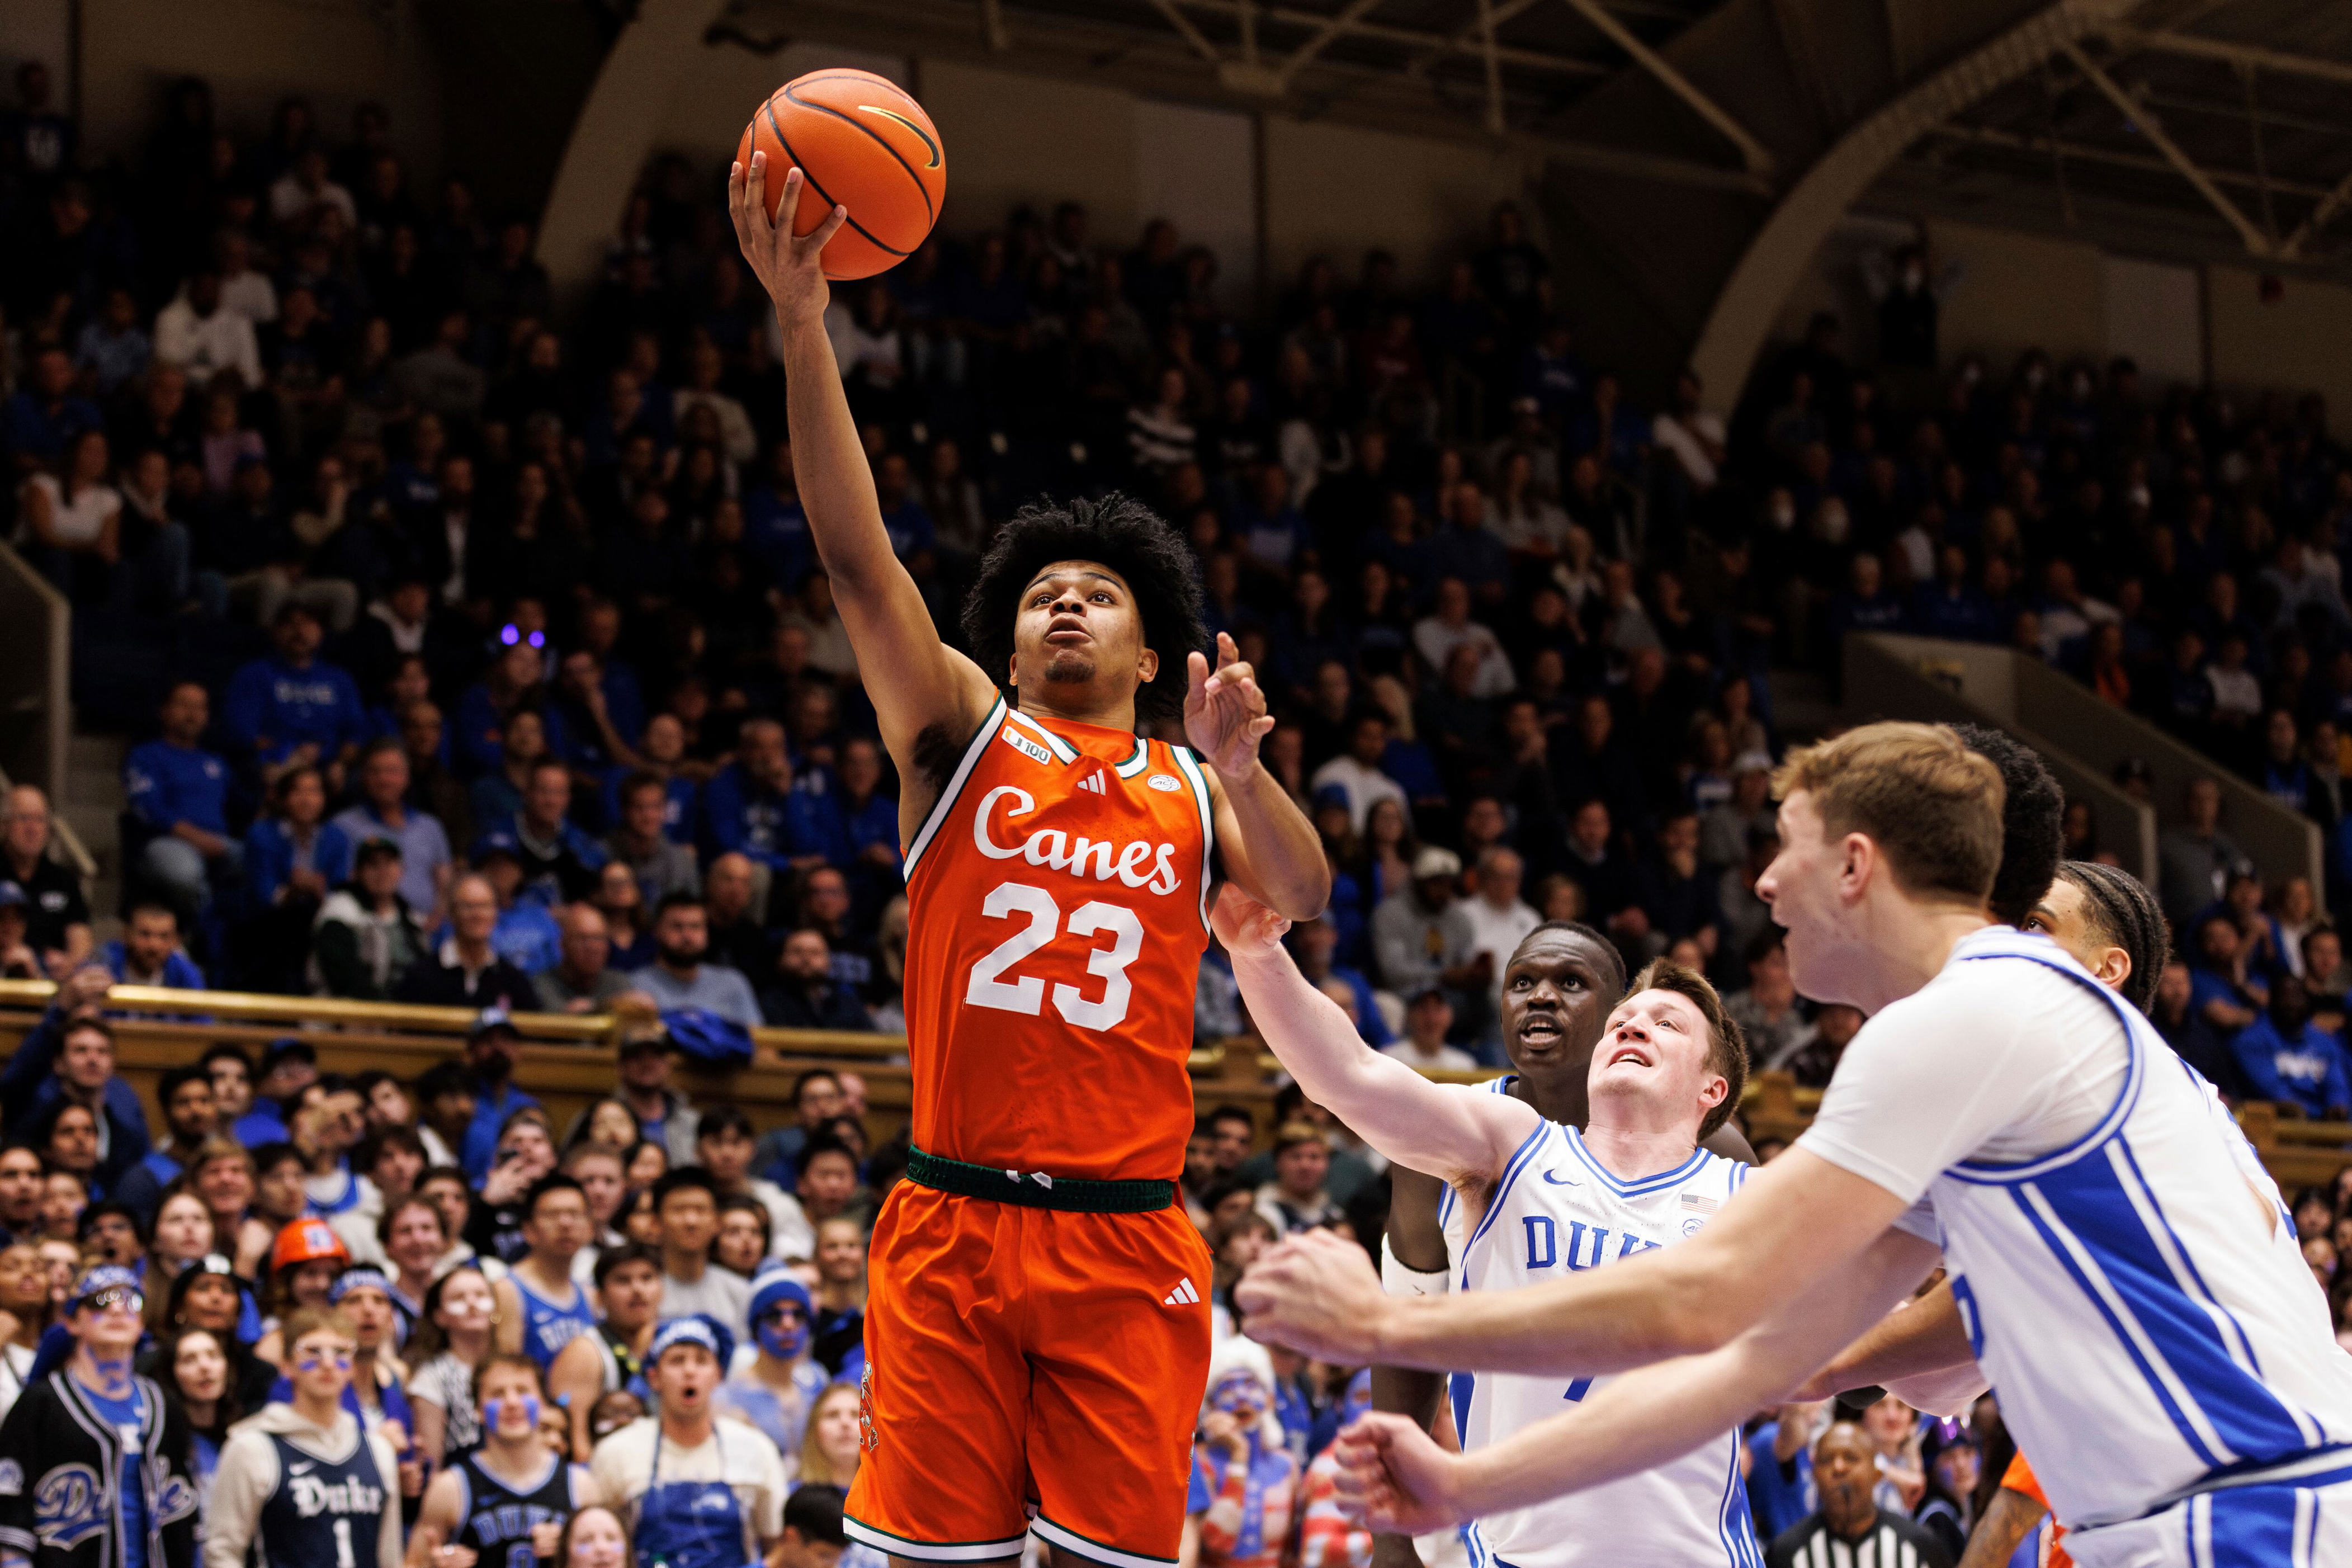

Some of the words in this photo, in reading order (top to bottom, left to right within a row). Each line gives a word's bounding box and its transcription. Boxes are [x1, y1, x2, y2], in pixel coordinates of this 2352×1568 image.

[1025, 742, 1049, 762] 100
[974, 786, 1182, 896] Canes
[966, 882, 1144, 1032] 23
[1522, 1216, 1663, 1272] DUK
[333, 1518, 356, 1568] 1
